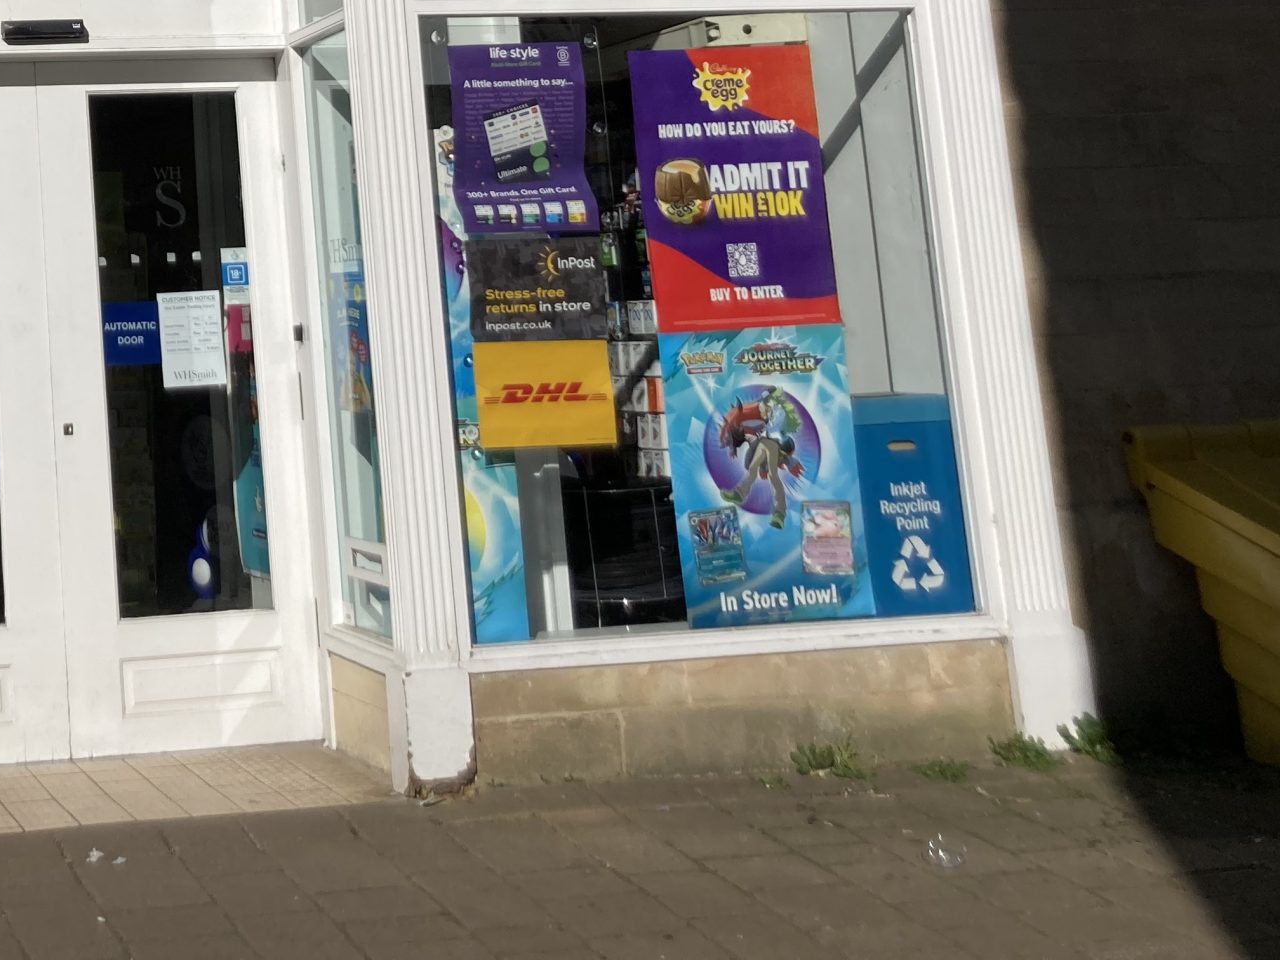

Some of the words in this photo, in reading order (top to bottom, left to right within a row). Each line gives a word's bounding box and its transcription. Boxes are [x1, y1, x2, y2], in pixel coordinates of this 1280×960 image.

[463, 80, 470, 88] A
[472, 79, 492, 88] little
[493, 78, 539, 89] something
[541, 78, 549, 86] to
[703, 78, 744, 91] creme
[711, 87, 738, 102] egg
[658, 123, 683, 139] HOW
[686, 122, 701, 137] DO
[704, 121, 726, 136] YOU
[729, 120, 750, 135] EAT
[752, 119, 795, 134] YOURS?
[152, 166, 182, 179] WH
[709, 161, 784, 192] ADMIT
[787, 160, 810, 189] IT
[466, 191, 489, 199] 300+
[520, 188, 538, 196] One
[539, 187, 555, 195] Gift
[156, 180, 186, 228] S
[713, 192, 755, 219] WIN
[558, 256, 596, 269] InPost
[485, 288, 565, 300] Stress-free
[710, 287, 731, 302] BUY
[736, 286, 749, 300] TO
[752, 284, 784, 300] ENTER
[486, 302, 537, 314] returns
[539, 300, 552, 312] in
[554, 300, 591, 312] store
[104, 321, 157, 331] AUTOMATIC
[485, 320, 552, 332] inpost.co.uk
[117, 335, 144, 345] DOOR
[741, 349, 791, 363] JOURNEY
[756, 357, 816, 371] TOGETHER
[173, 369, 218, 381] WHSmith
[501, 381, 589, 403] DHL
[889, 481, 927, 498] Inkjet
[880, 498, 941, 516] Recycling
[895, 515, 929, 531] Point
[720, 591, 738, 612] In
[742, 589, 788, 610] Store
[792, 583, 838, 606] Now!
